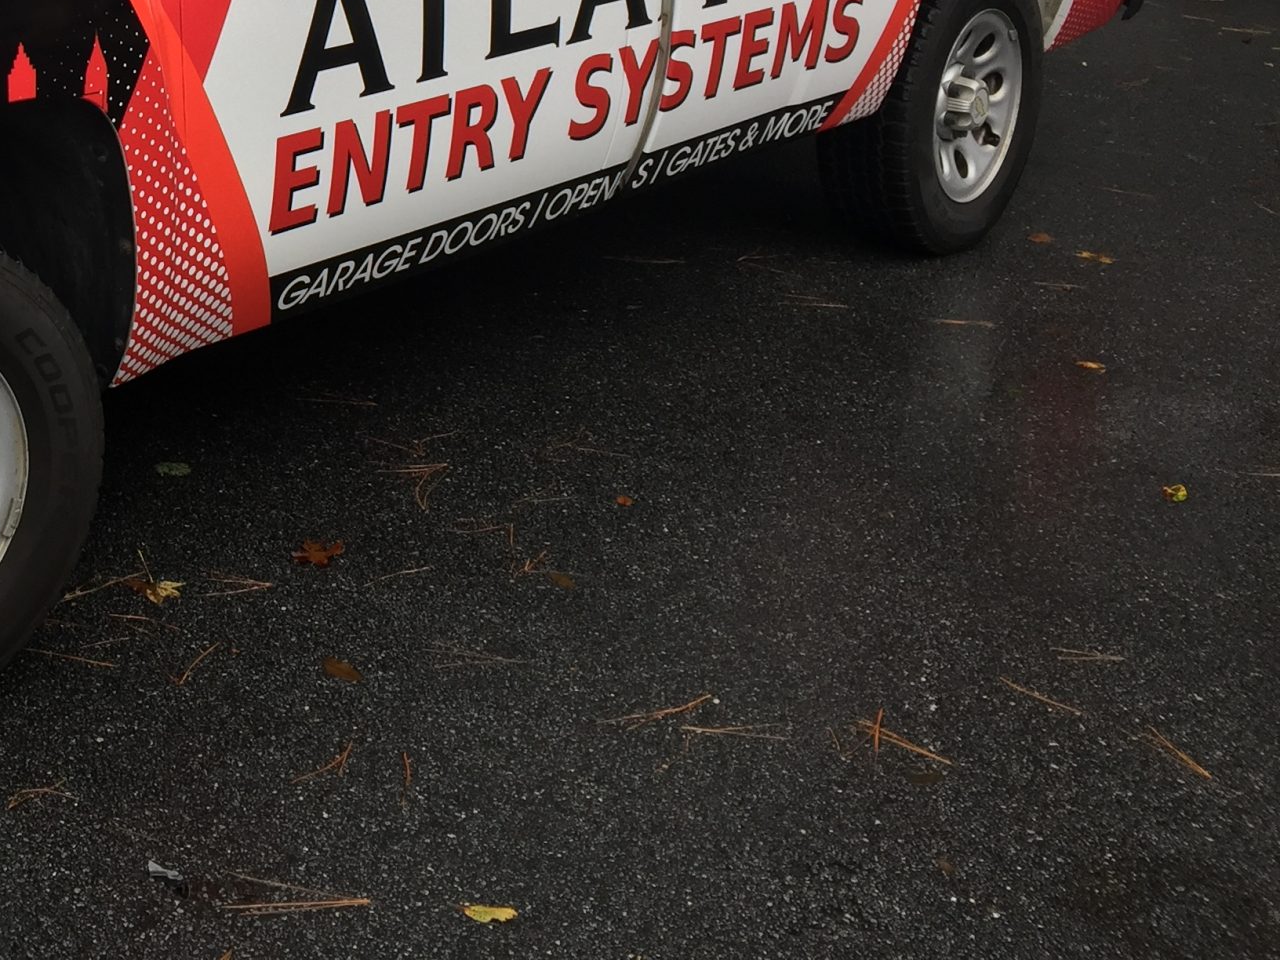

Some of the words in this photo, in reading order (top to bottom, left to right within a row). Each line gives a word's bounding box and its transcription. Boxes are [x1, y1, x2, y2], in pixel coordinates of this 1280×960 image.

[267, 66, 553, 235] ENTRY
[277, 236, 423, 310] GARAGE
[418, 201, 531, 265] DOORS
[544, 157, 654, 221] OPENS
[666, 128, 741, 177] GATES
[738, 122, 760, 153] &
[758, 100, 834, 146] MORE
